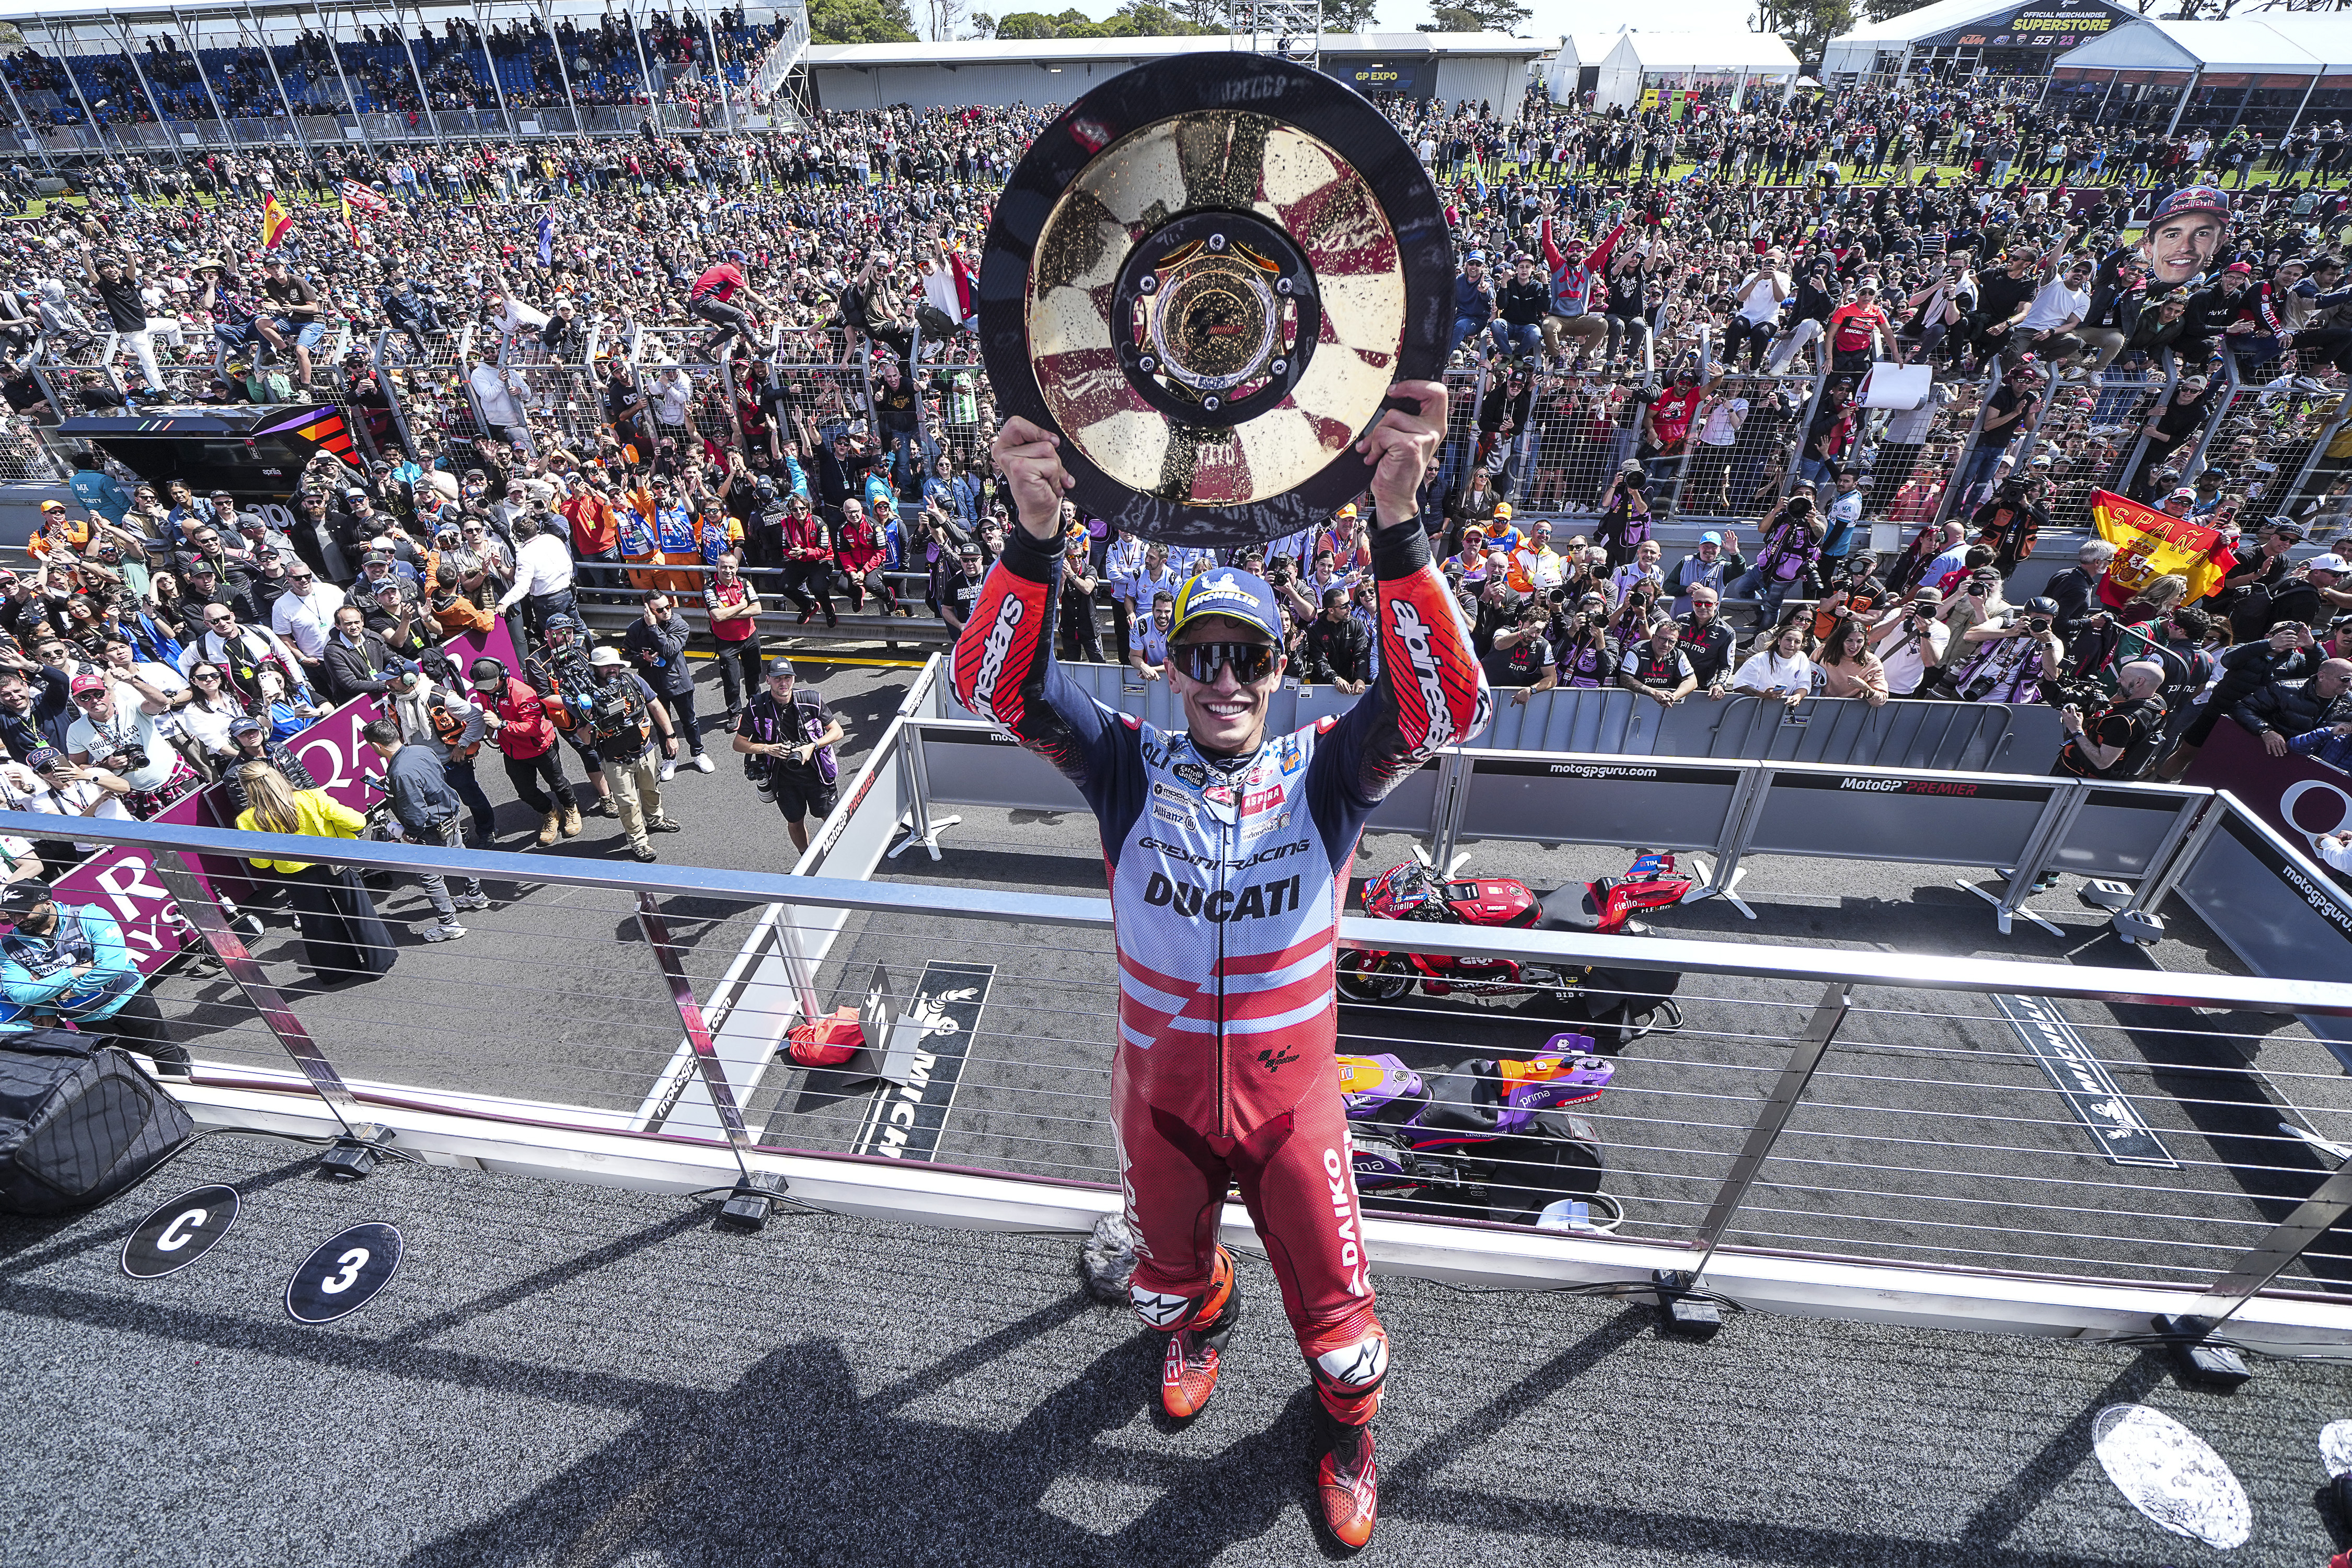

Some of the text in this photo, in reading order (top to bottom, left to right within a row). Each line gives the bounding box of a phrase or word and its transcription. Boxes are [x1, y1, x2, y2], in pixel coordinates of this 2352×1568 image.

[2012, 19, 2112, 31] SUPERSTORE
[1958, 35, 1986, 45] KTM
[2032, 35, 2054, 45] 93
[2060, 35, 2075, 45] 23
[1356, 72, 1398, 80] GP EXPO
[2193, 199, 2215, 209] Bull
[1187, 592, 1259, 610] MICHELIN
[1680, 641, 1706, 653] prima
[32, 748, 53, 764] 89
[1179, 770, 1201, 786] Galicia
[1180, 765, 1203, 778] Estrella
[1550, 763, 1657, 778] motogpguru.com
[847, 769, 876, 816] PREMIER
[1906, 781, 1978, 795] PREMIER
[1244, 787, 1279, 808] ASPIRA
[1154, 805, 1183, 824] Allianz
[1138, 837, 1310, 870] GRESINI RACING
[1144, 871, 1300, 923] DUCATI
[1394, 902, 1414, 910] riello
[1615, 899, 1638, 912] riello
[878, 1048, 936, 1159] MICH
[1350, 1097, 1371, 1107] DUCATI
[1520, 1089, 1550, 1108] prima
[1564, 1093, 1599, 1105] MOTUL
[157, 1208, 207, 1251] C
[321, 1248, 370, 1294] 3
